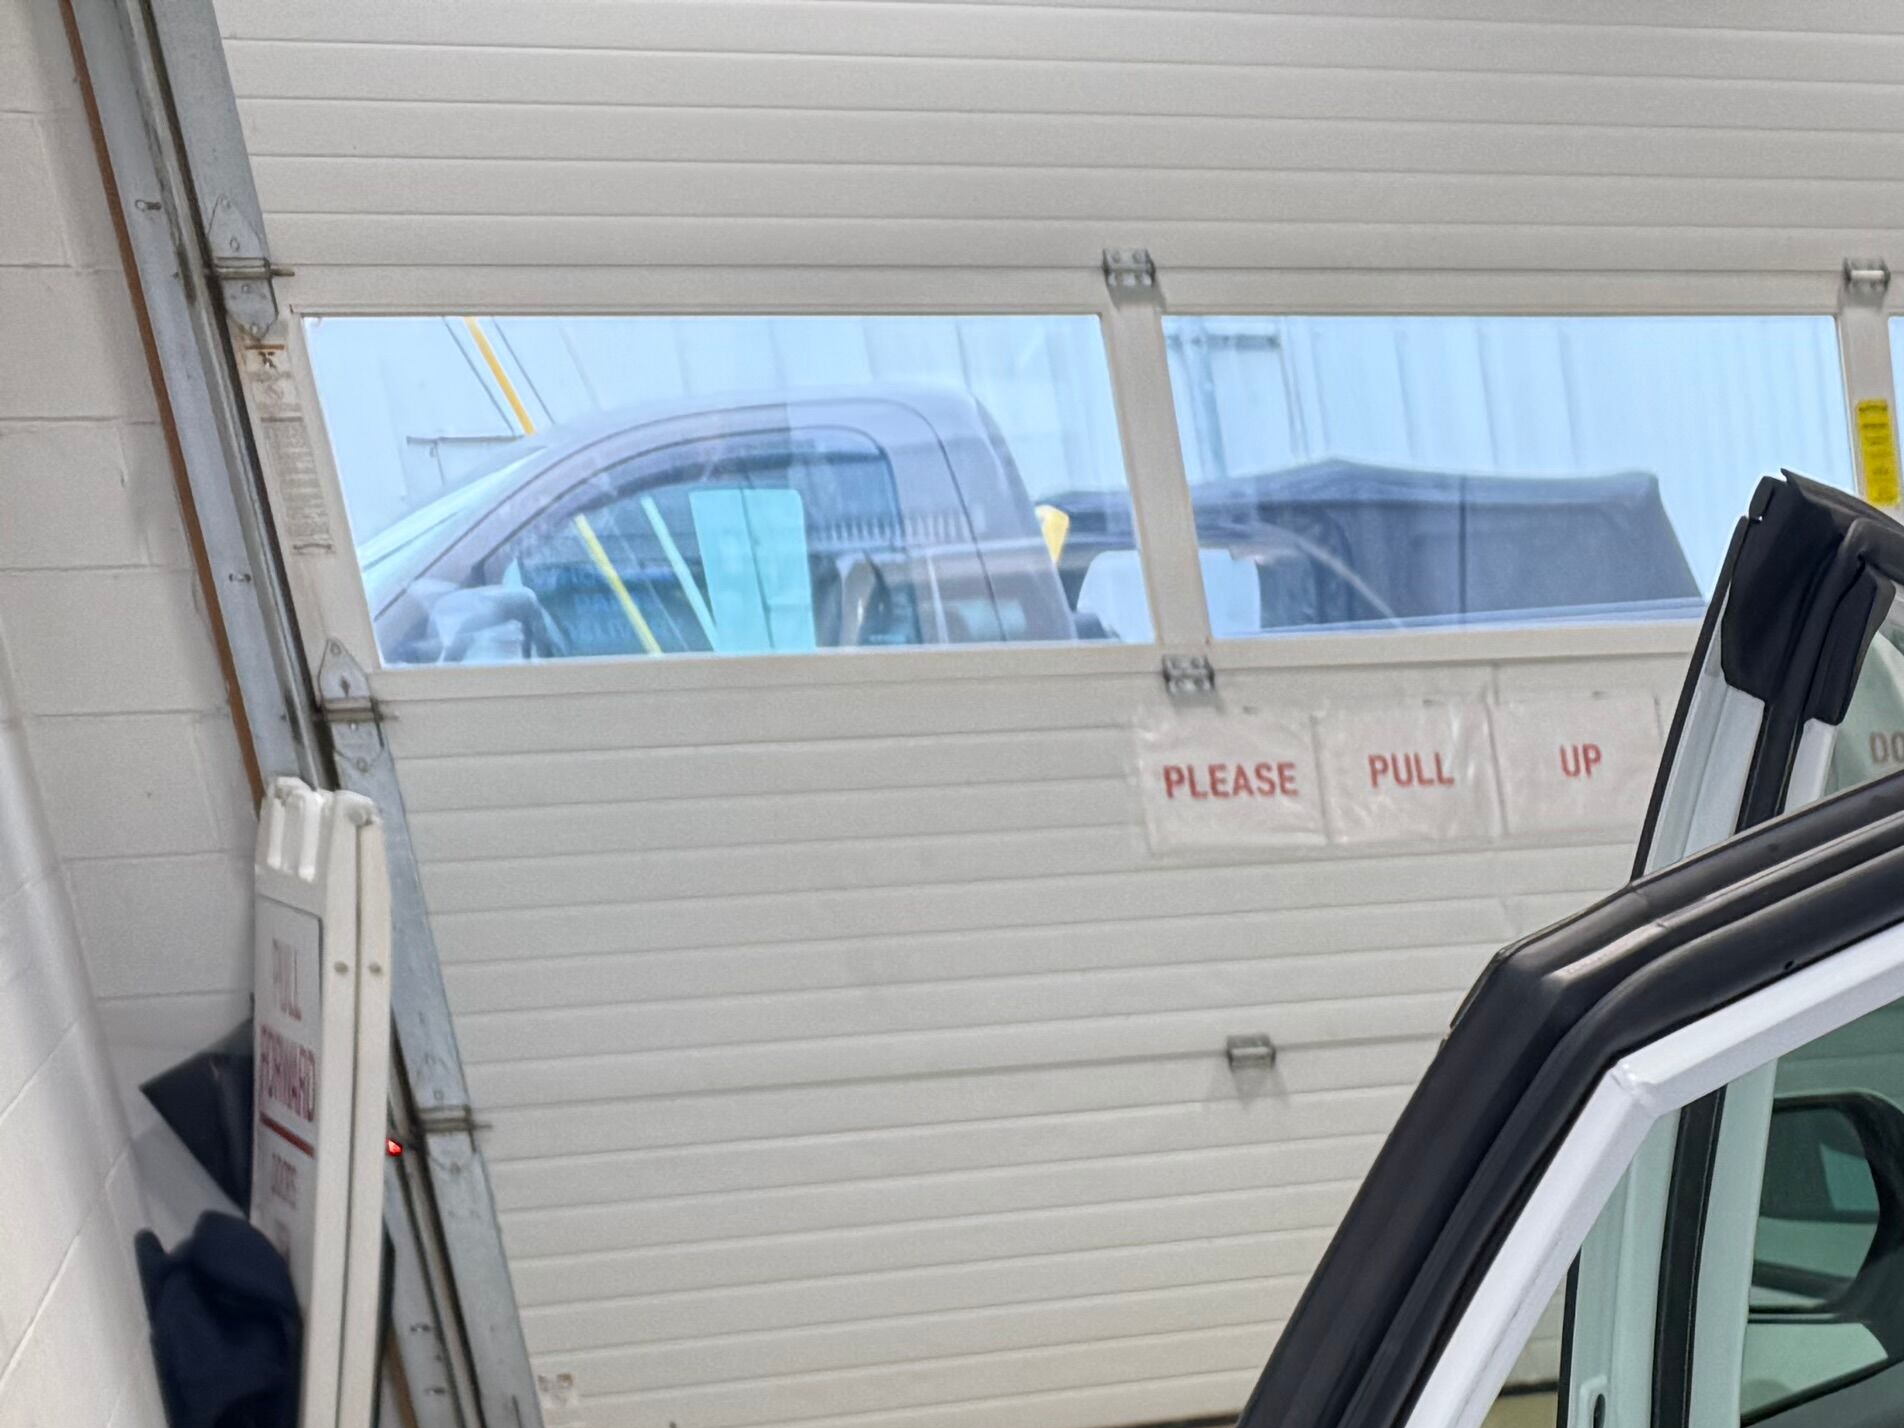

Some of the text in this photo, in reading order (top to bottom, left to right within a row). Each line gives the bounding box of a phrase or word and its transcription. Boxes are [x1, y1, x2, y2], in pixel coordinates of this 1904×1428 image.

[1163, 762, 1298, 799] PLEASE
[1368, 752, 1455, 788] PULL
[1559, 744, 1602, 779] UP
